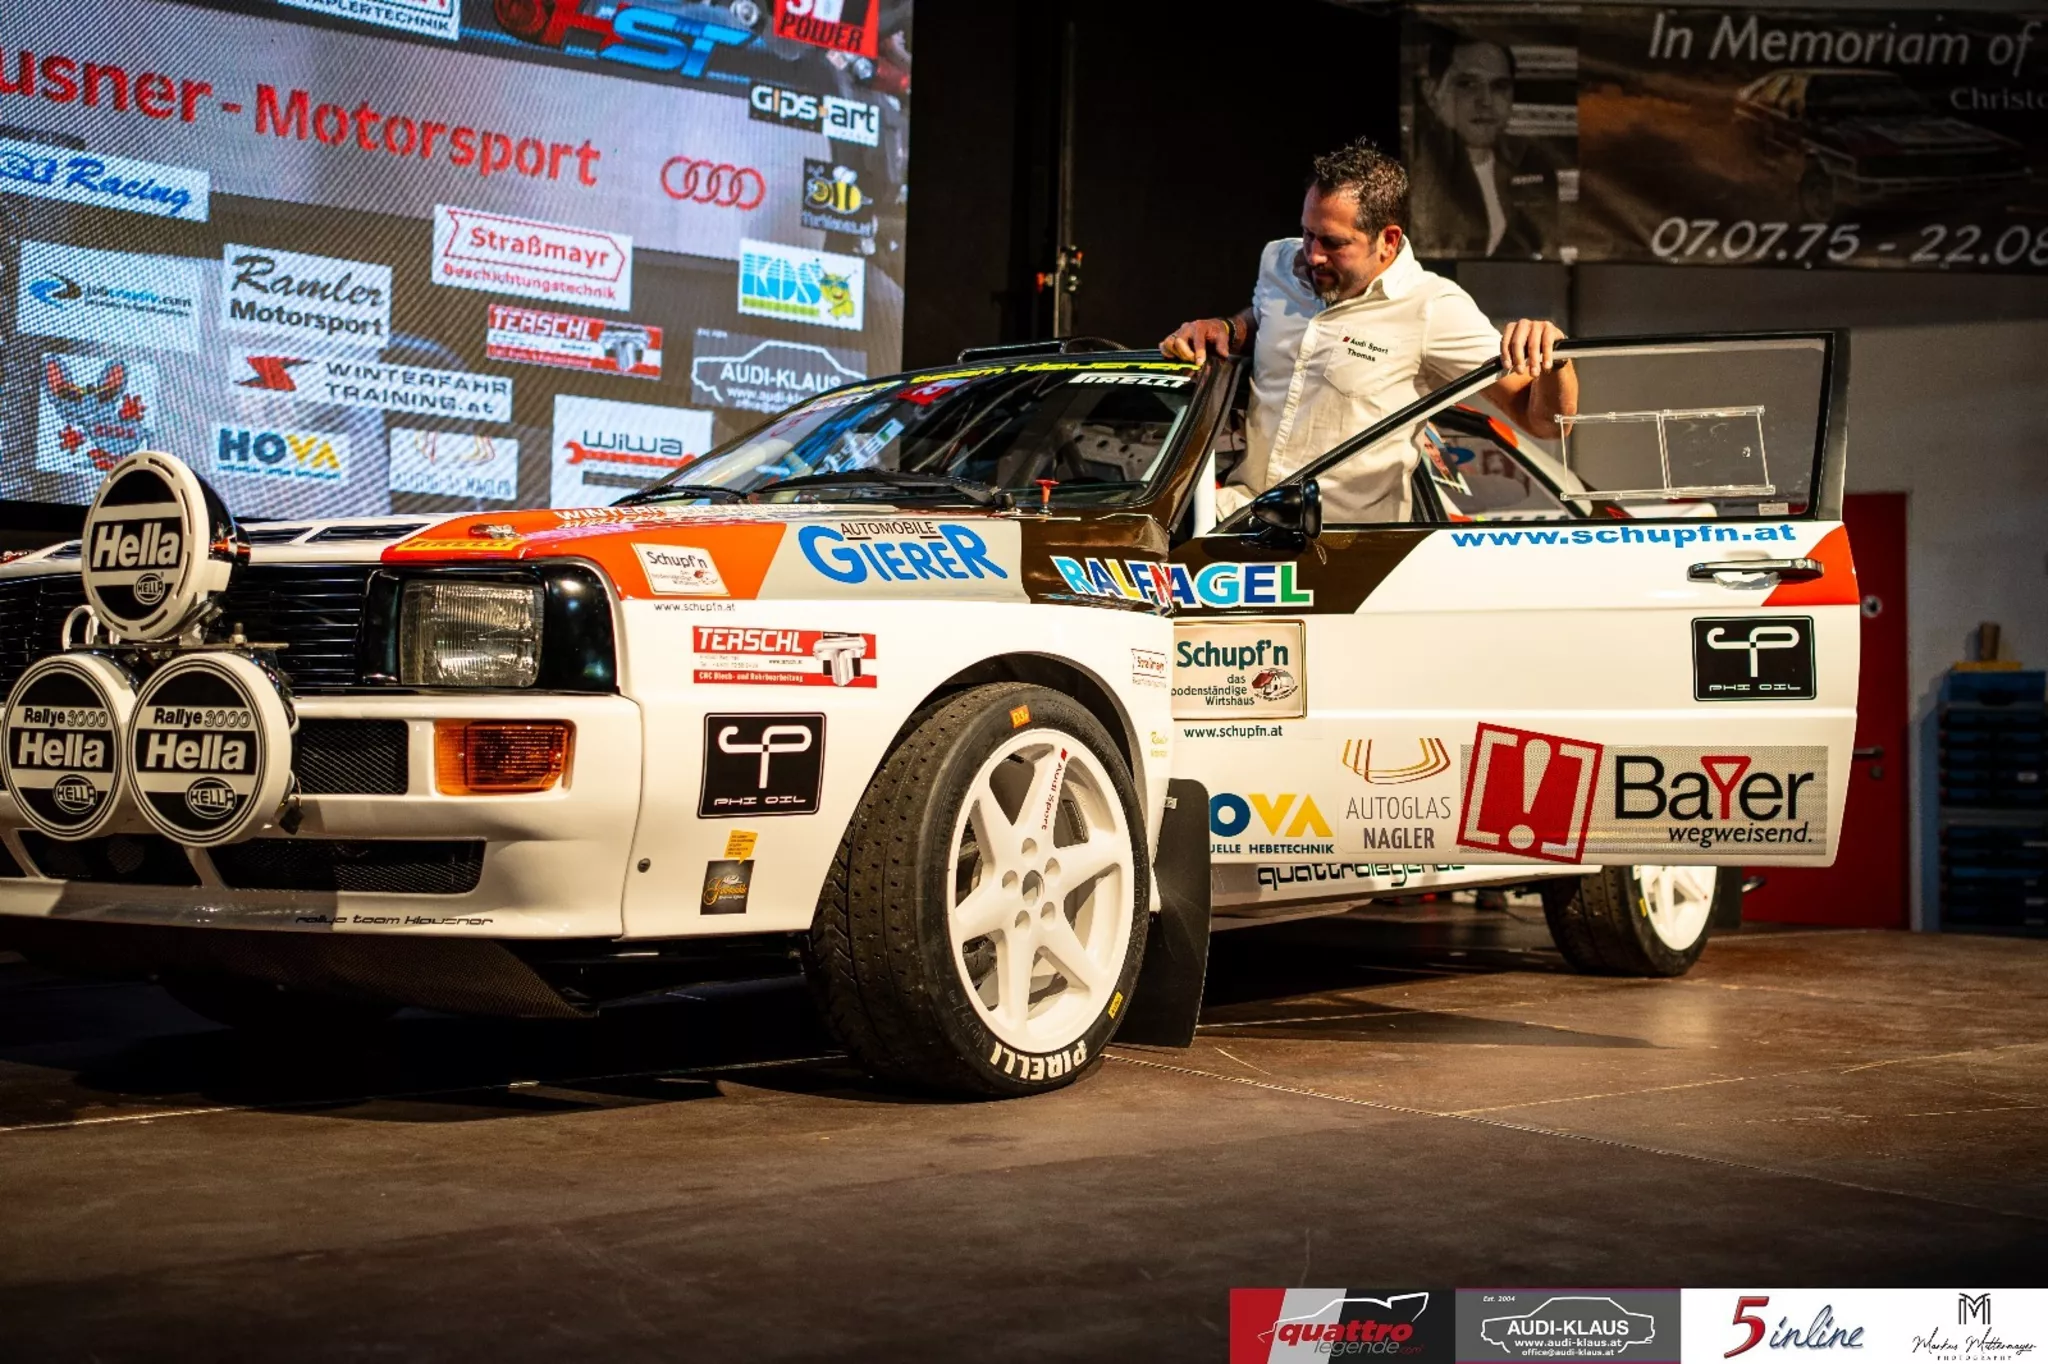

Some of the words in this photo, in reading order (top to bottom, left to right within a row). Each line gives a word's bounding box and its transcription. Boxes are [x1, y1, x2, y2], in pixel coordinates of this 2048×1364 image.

[781, 14, 863, 51] POWER
[1648, 12, 1694, 60] In
[1707, 14, 1971, 65] Memoriam
[1988, 20, 2043, 78] of
[65, 156, 191, 215] Racing
[470, 226, 610, 269] Straßmayr
[1651, 216, 1861, 262] 07.07.75
[231, 254, 382, 307] Ramler
[443, 262, 617, 301] Beschichtungstechnik
[230, 298, 382, 336] Motorsport
[1347, 347, 1376, 362] Thomas
[1350, 338, 1366, 348] Audi
[1367, 342, 1389, 355] Sport
[326, 362, 508, 396] WINTERFAHR
[1067, 371, 1192, 390] PIRELLI
[325, 383, 494, 415] TRAINING.at
[218, 428, 341, 470] HOVA
[840, 521, 937, 536] AUTOMOBILE
[1451, 524, 1796, 549] www.schupfn.at
[93, 523, 181, 569] Hella
[798, 524, 1008, 584] GIERER
[136, 581, 164, 596] HELLA
[1049, 554, 1157, 602] RALF
[1147, 560, 1315, 608] NAGEL
[698, 627, 804, 654] TERSCHL
[1176, 639, 1289, 671] Schupf'n
[1227, 673, 1247, 685] das
[1708, 683, 1751, 692] PHI
[1758, 683, 1803, 692] OIL
[1205, 695, 1256, 707] Wirtshaus
[23, 707, 67, 727] Rallye
[66, 710, 108, 728] 3000
[153, 707, 203, 727] Rallye
[203, 710, 252, 728] 3000
[1184, 724, 1284, 740] www.schupfn.at
[18, 731, 106, 769] Hella
[145, 733, 247, 772] Hella
[56, 786, 97, 803] HELLA
[188, 788, 237, 808] HELLA
[714, 796, 757, 806] PHI
[764, 795, 806, 804] OIL
[1346, 796, 1452, 821] AUTOGLAS
[1363, 827, 1435, 850] NAGLER
[1668, 822, 1813, 848] wegweisend.
[1249, 843, 1335, 855] HEBETECHNIK
[990, 1040, 1088, 1080] PIRELLI
